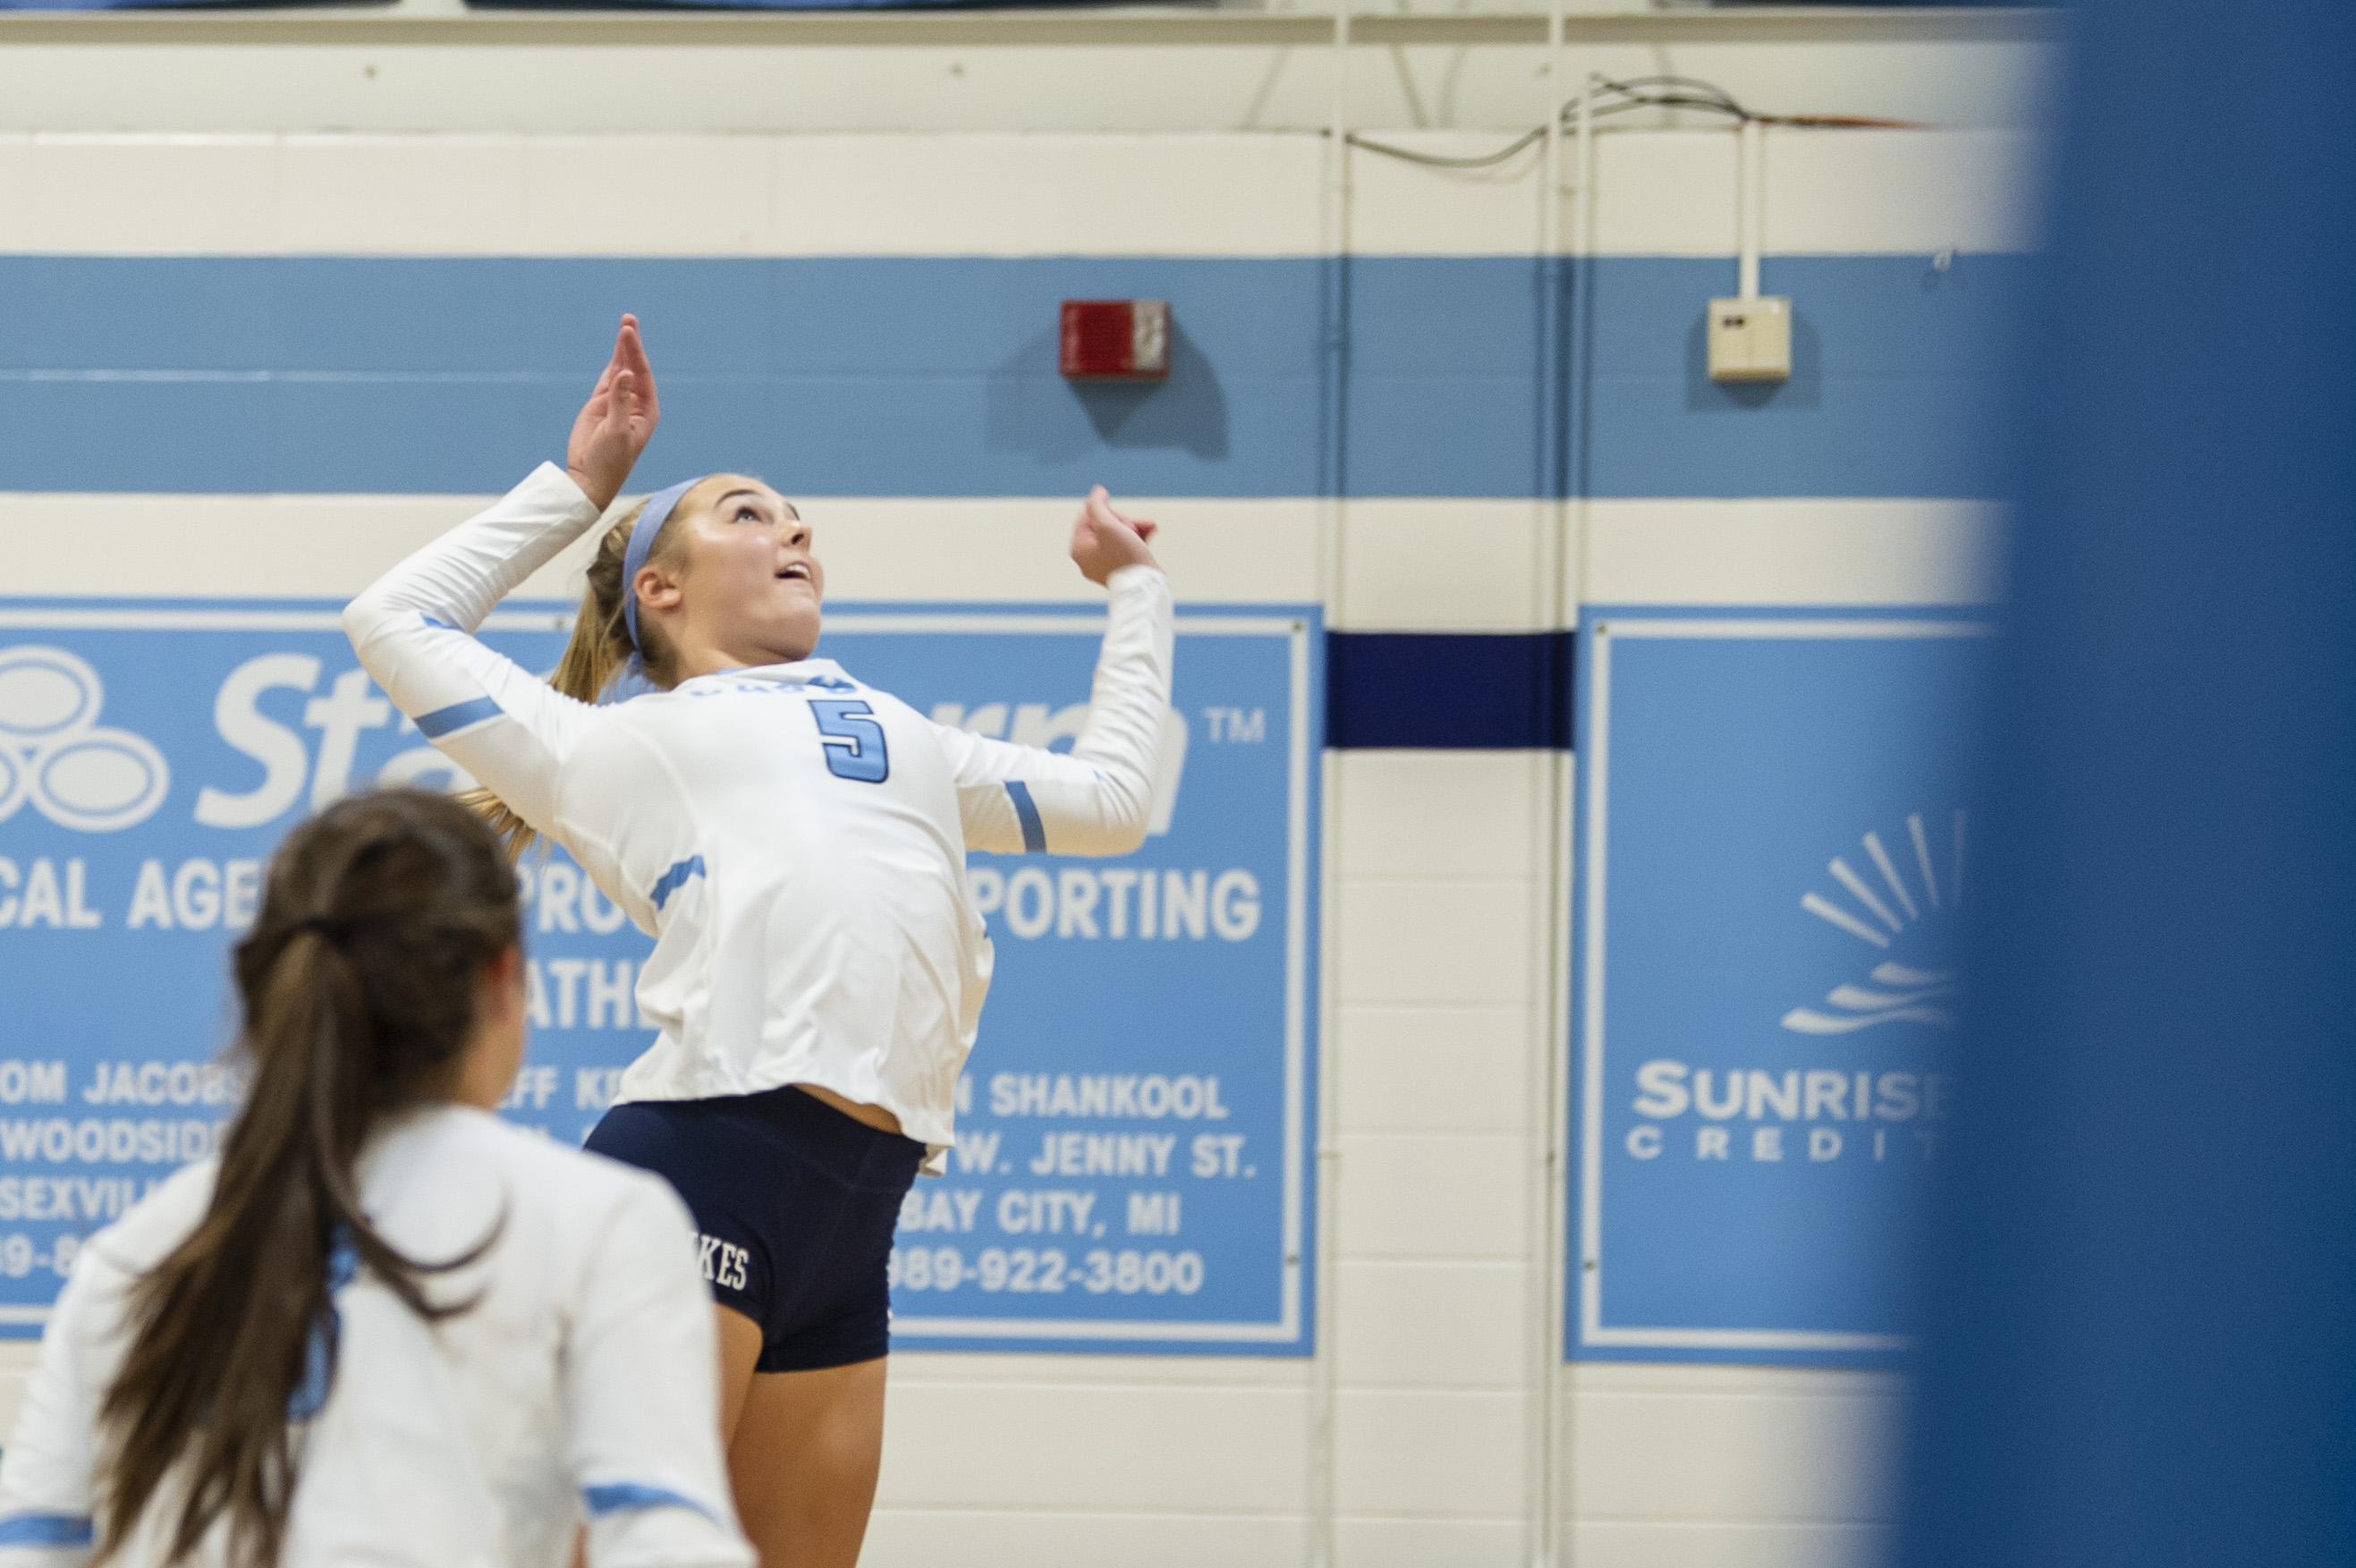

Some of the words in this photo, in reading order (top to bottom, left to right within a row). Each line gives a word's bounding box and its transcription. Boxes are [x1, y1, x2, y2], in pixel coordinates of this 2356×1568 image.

[807, 699, 889, 784] 5
[1205, 708, 1266, 743] TM
[989, 1072, 1229, 1119] SHANKOOL
[953, 1132, 1012, 1175] W.
[1031, 1132, 1176, 1177] JENNY
[1191, 1134, 1257, 1178] ST.
[1625, 1125, 1936, 1163] CREDI
[897, 1190, 981, 1233] BAY
[997, 1190, 1107, 1240] CITY,
[1126, 1192, 1181, 1236] MI
